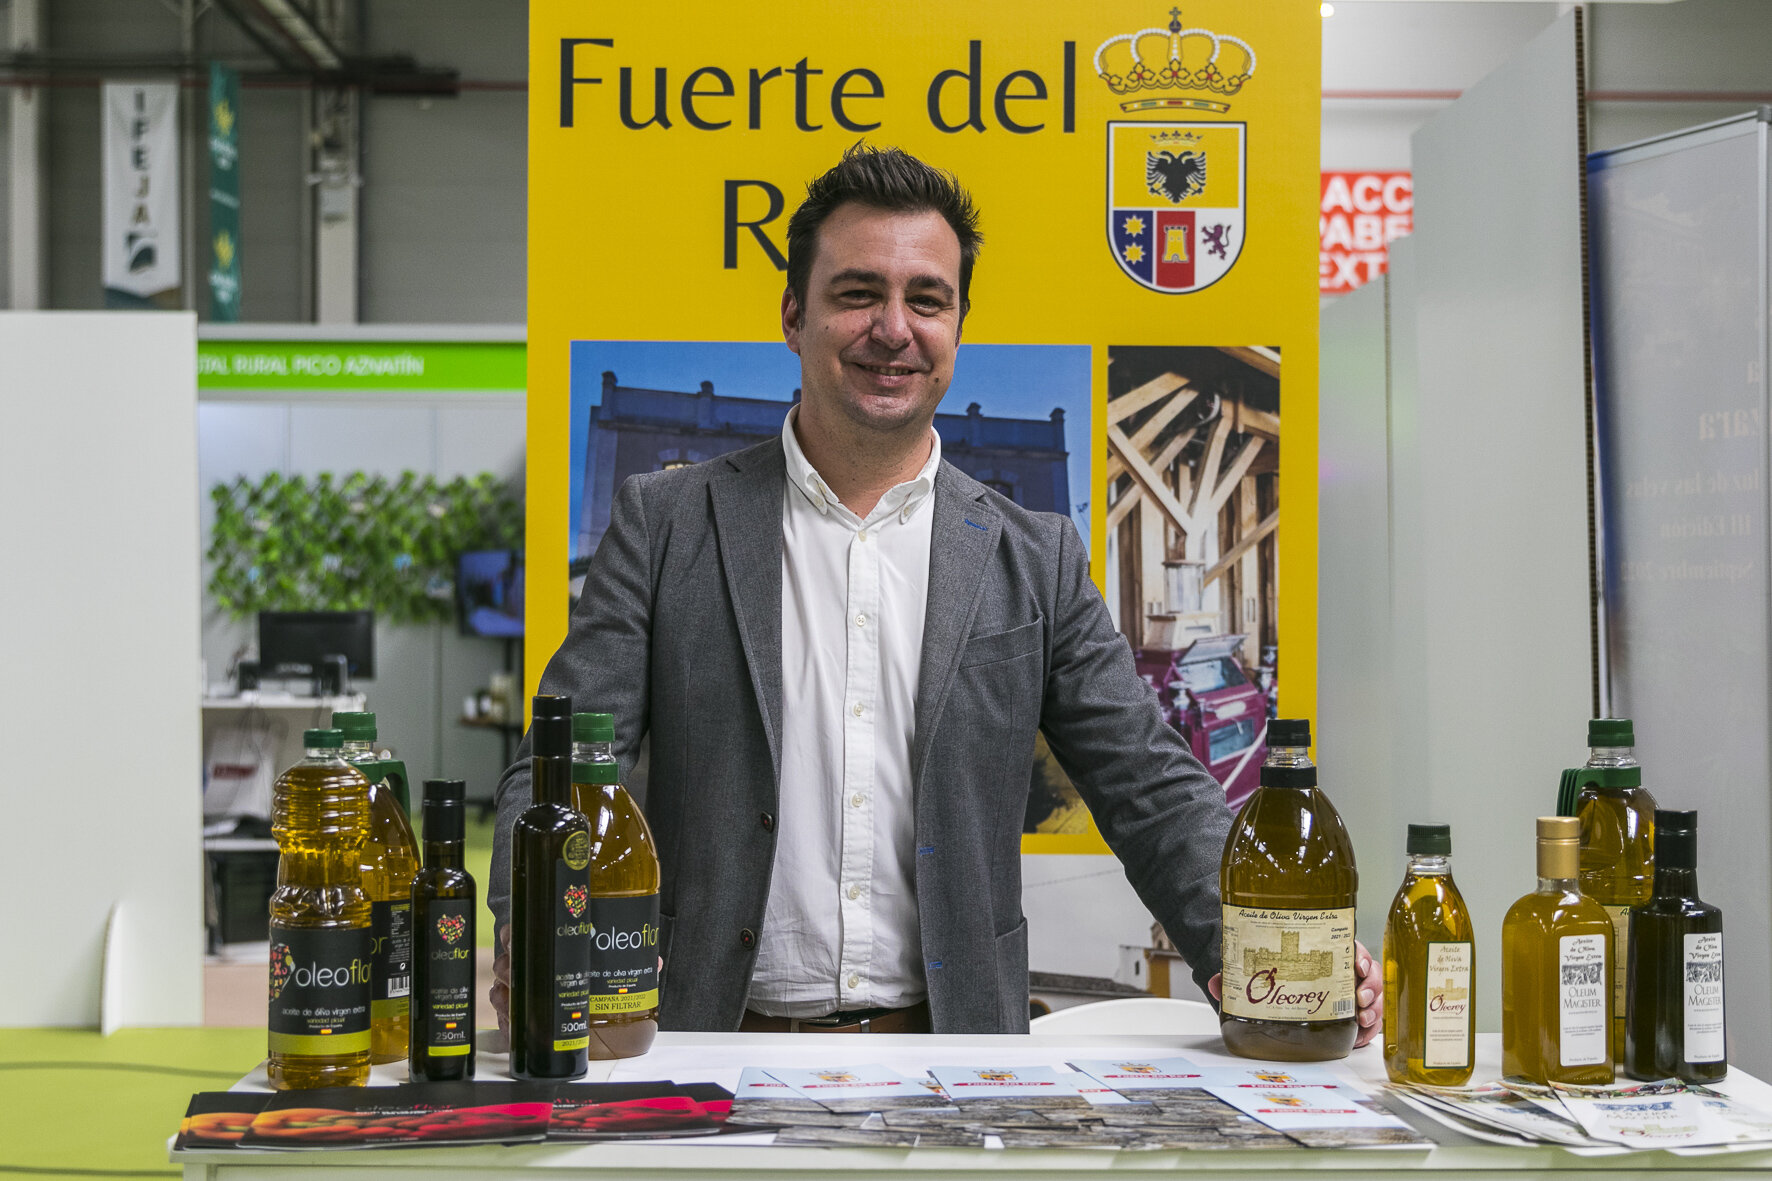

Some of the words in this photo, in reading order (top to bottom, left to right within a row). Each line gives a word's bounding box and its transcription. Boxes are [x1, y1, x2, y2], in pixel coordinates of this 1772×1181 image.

[559, 38, 885, 132] Fuerte
[927, 40, 1076, 134] del
[232, 354, 289, 376] RURAL
[292, 354, 342, 376] PICO
[1238, 908, 1258, 918] Aceite
[1259, 910, 1268, 919] de
[1269, 911, 1290, 920] Oliva
[1292, 911, 1318, 923] Virgen
[1319, 912, 1338, 920] Extra
[1568, 986, 1597, 998] OLEUM
[594, 1003, 610, 1011] SIN
[611, 1002, 642, 1011] FILTRAR
[1563, 998, 1602, 1009] MAGISTER
